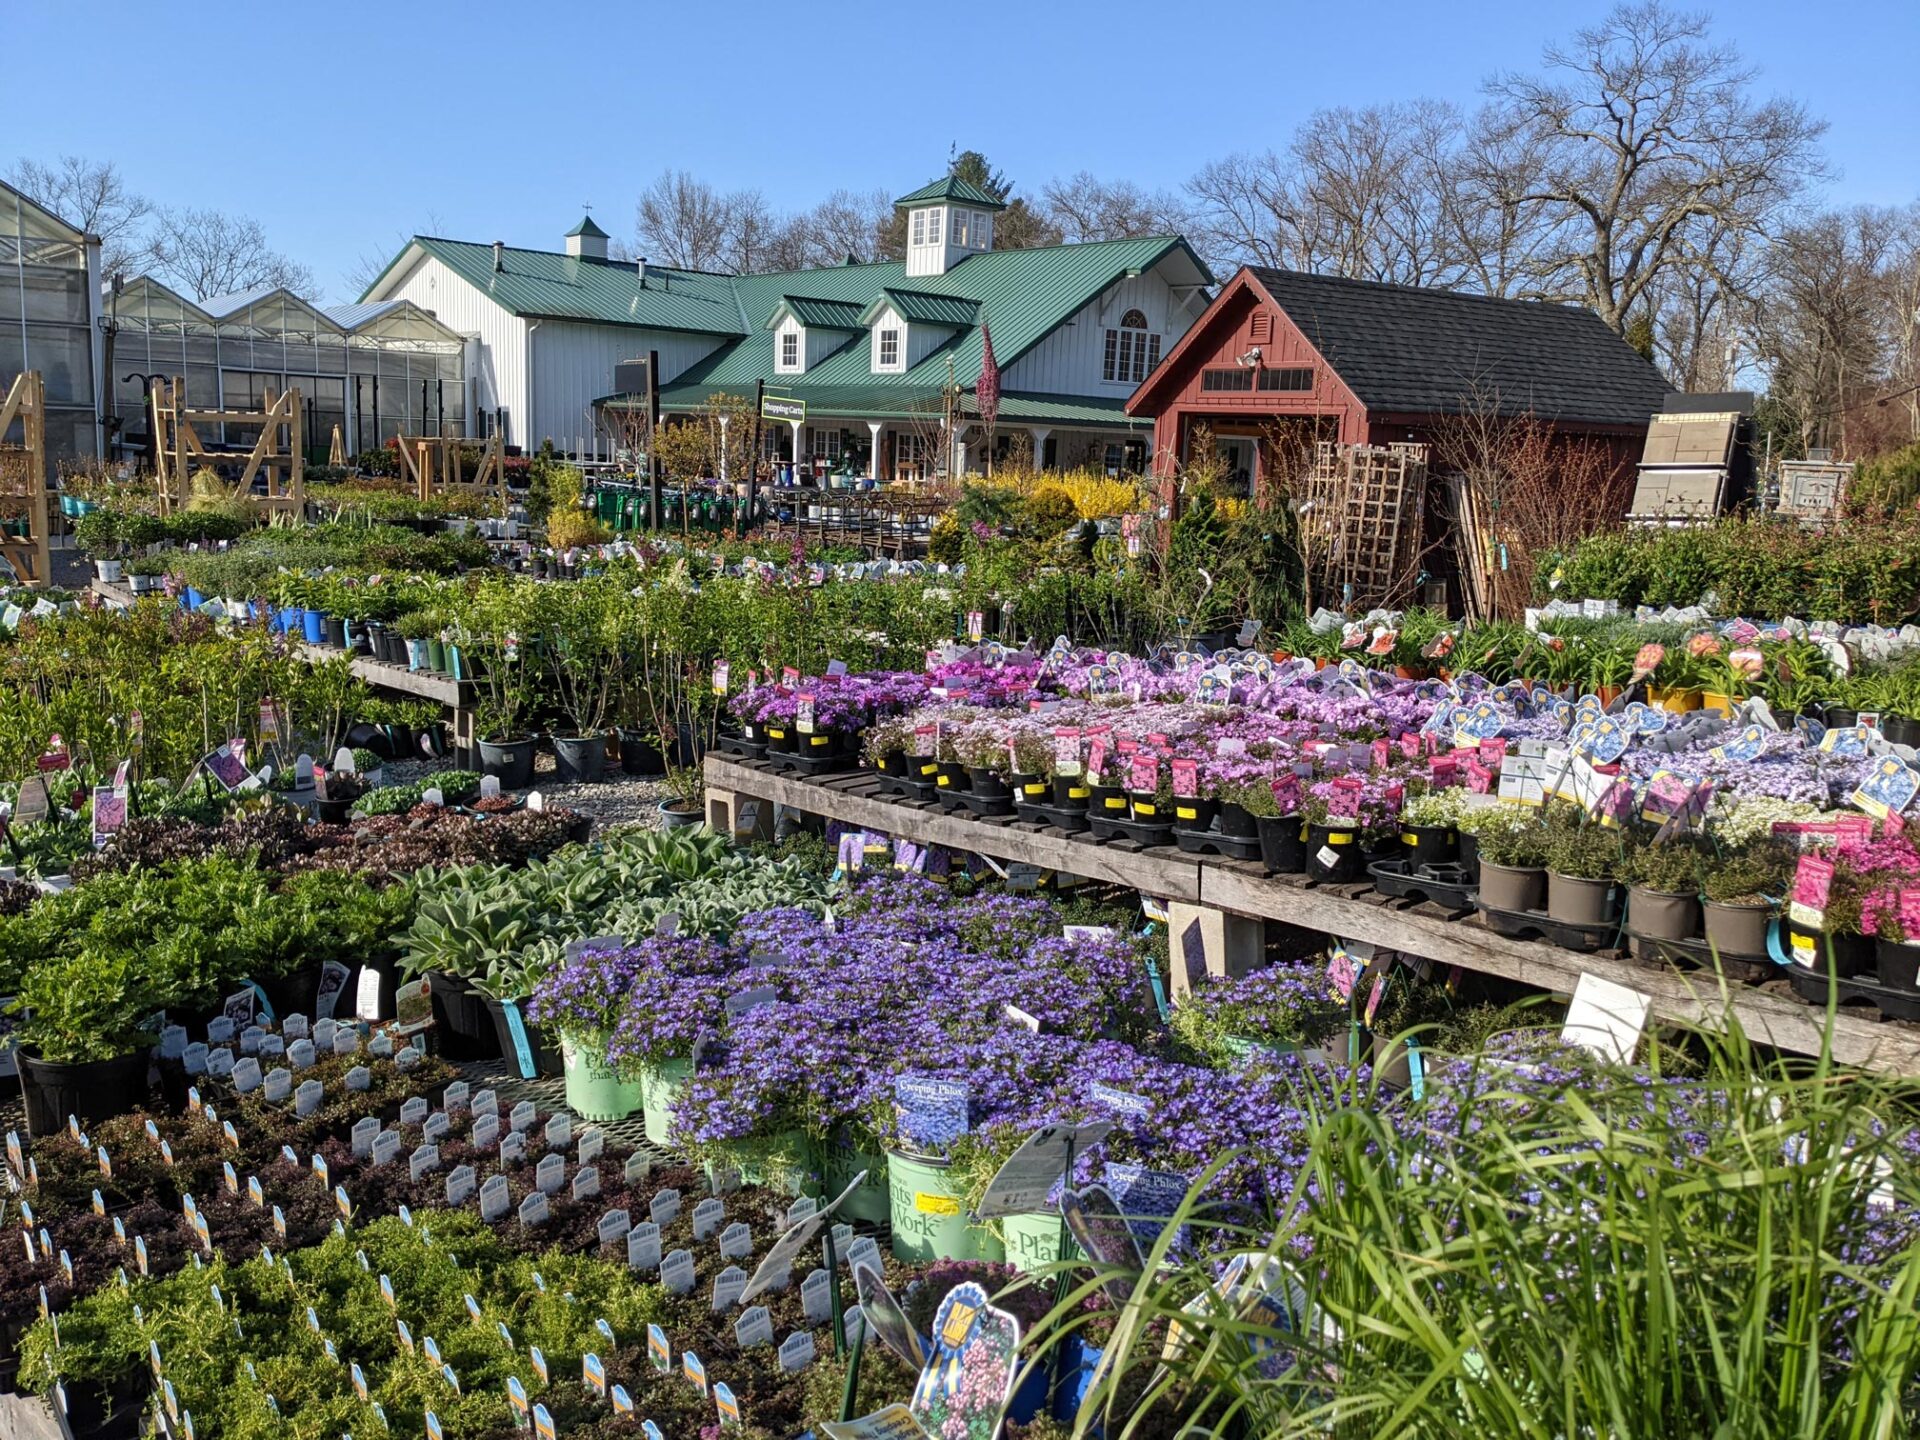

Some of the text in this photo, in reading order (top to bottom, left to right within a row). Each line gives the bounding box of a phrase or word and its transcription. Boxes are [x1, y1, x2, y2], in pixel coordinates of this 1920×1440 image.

[764, 402, 803, 415] Shopping Carts
[900, 1080, 963, 1096] Creeping Phlox
[1094, 1088, 1122, 1107] Creeping
[1111, 1168, 1181, 1190] Creeping Phlox
[891, 1202, 936, 1238] Work
